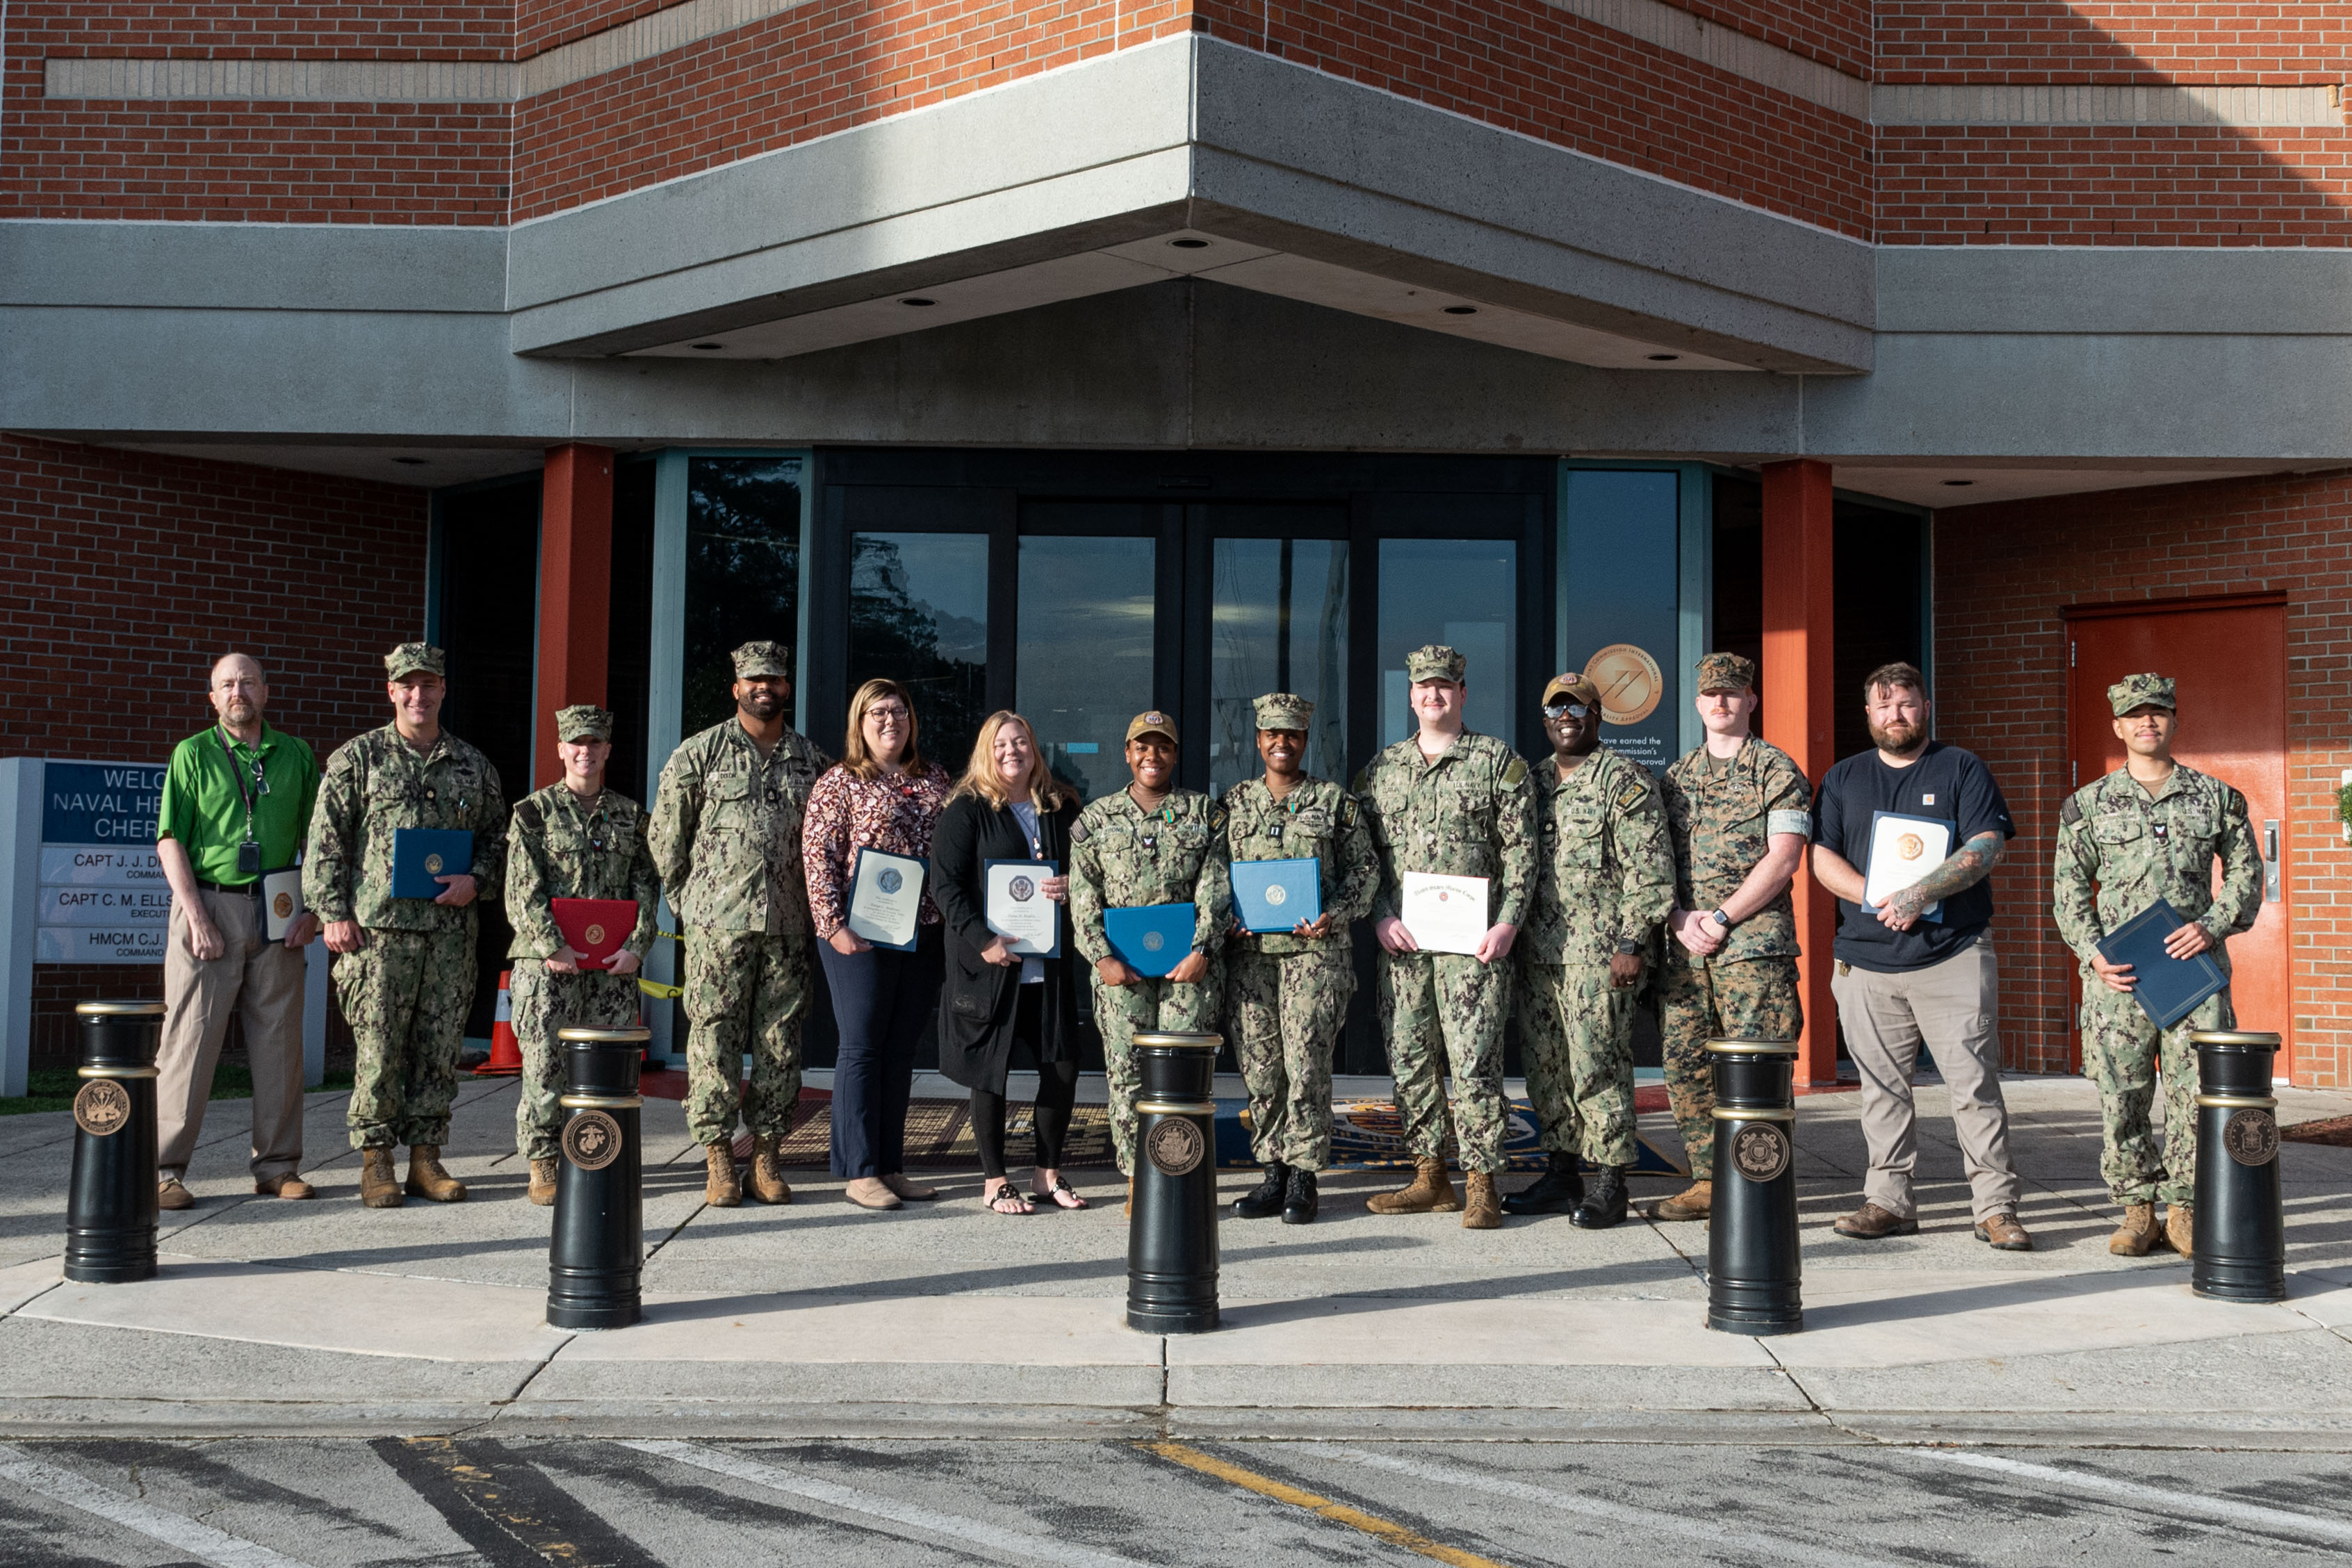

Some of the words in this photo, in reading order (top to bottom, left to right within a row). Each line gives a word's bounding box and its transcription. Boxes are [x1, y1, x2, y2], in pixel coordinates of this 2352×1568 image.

[1619, 736, 1647, 744] earned
[1649, 737, 1661, 745] the
[1609, 746, 1657, 756] mmission's
[54, 792, 128, 813] NAVAL
[95, 818, 158, 838] CHER
[74, 854, 113, 867] CAPT
[117, 856, 128, 867] J.
[132, 856, 142, 868] J.
[59, 892, 99, 906] CAPT
[102, 893, 117, 906] C.
[121, 894, 136, 906] M.
[90, 933, 134, 945] HMCM
[138, 933, 163, 946] C.J.
[116, 948, 165, 957] COMMAND
